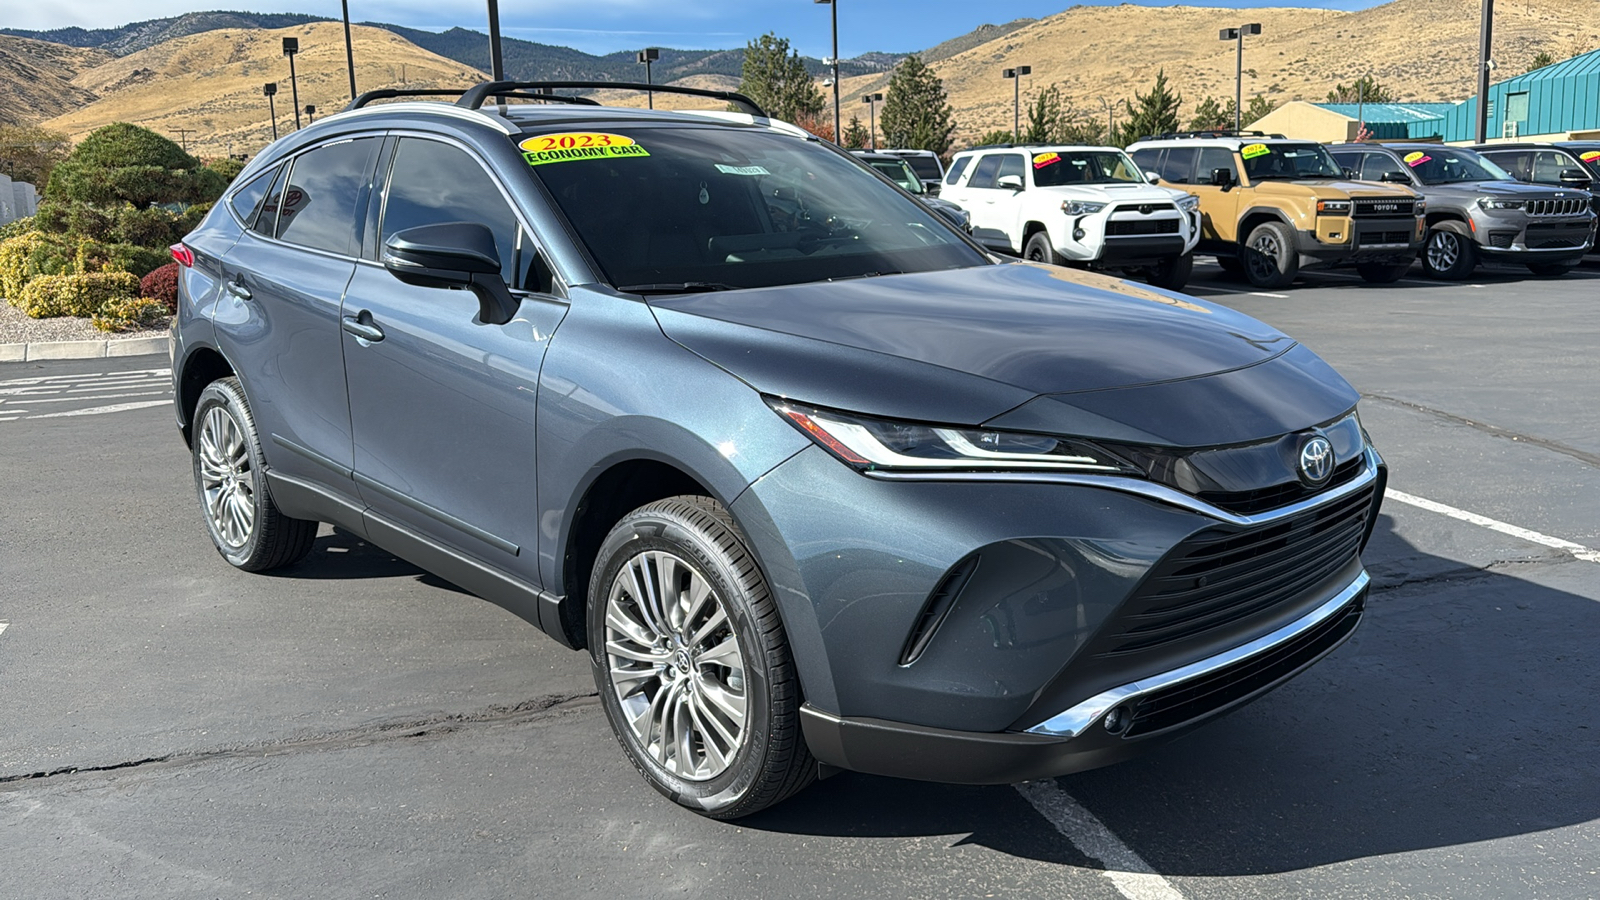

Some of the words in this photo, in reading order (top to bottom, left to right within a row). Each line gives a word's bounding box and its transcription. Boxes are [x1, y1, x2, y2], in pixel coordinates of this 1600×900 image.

[541, 135, 612, 150] 2023
[527, 147, 606, 162] ECONOMY
[609, 145, 642, 155] CAR
